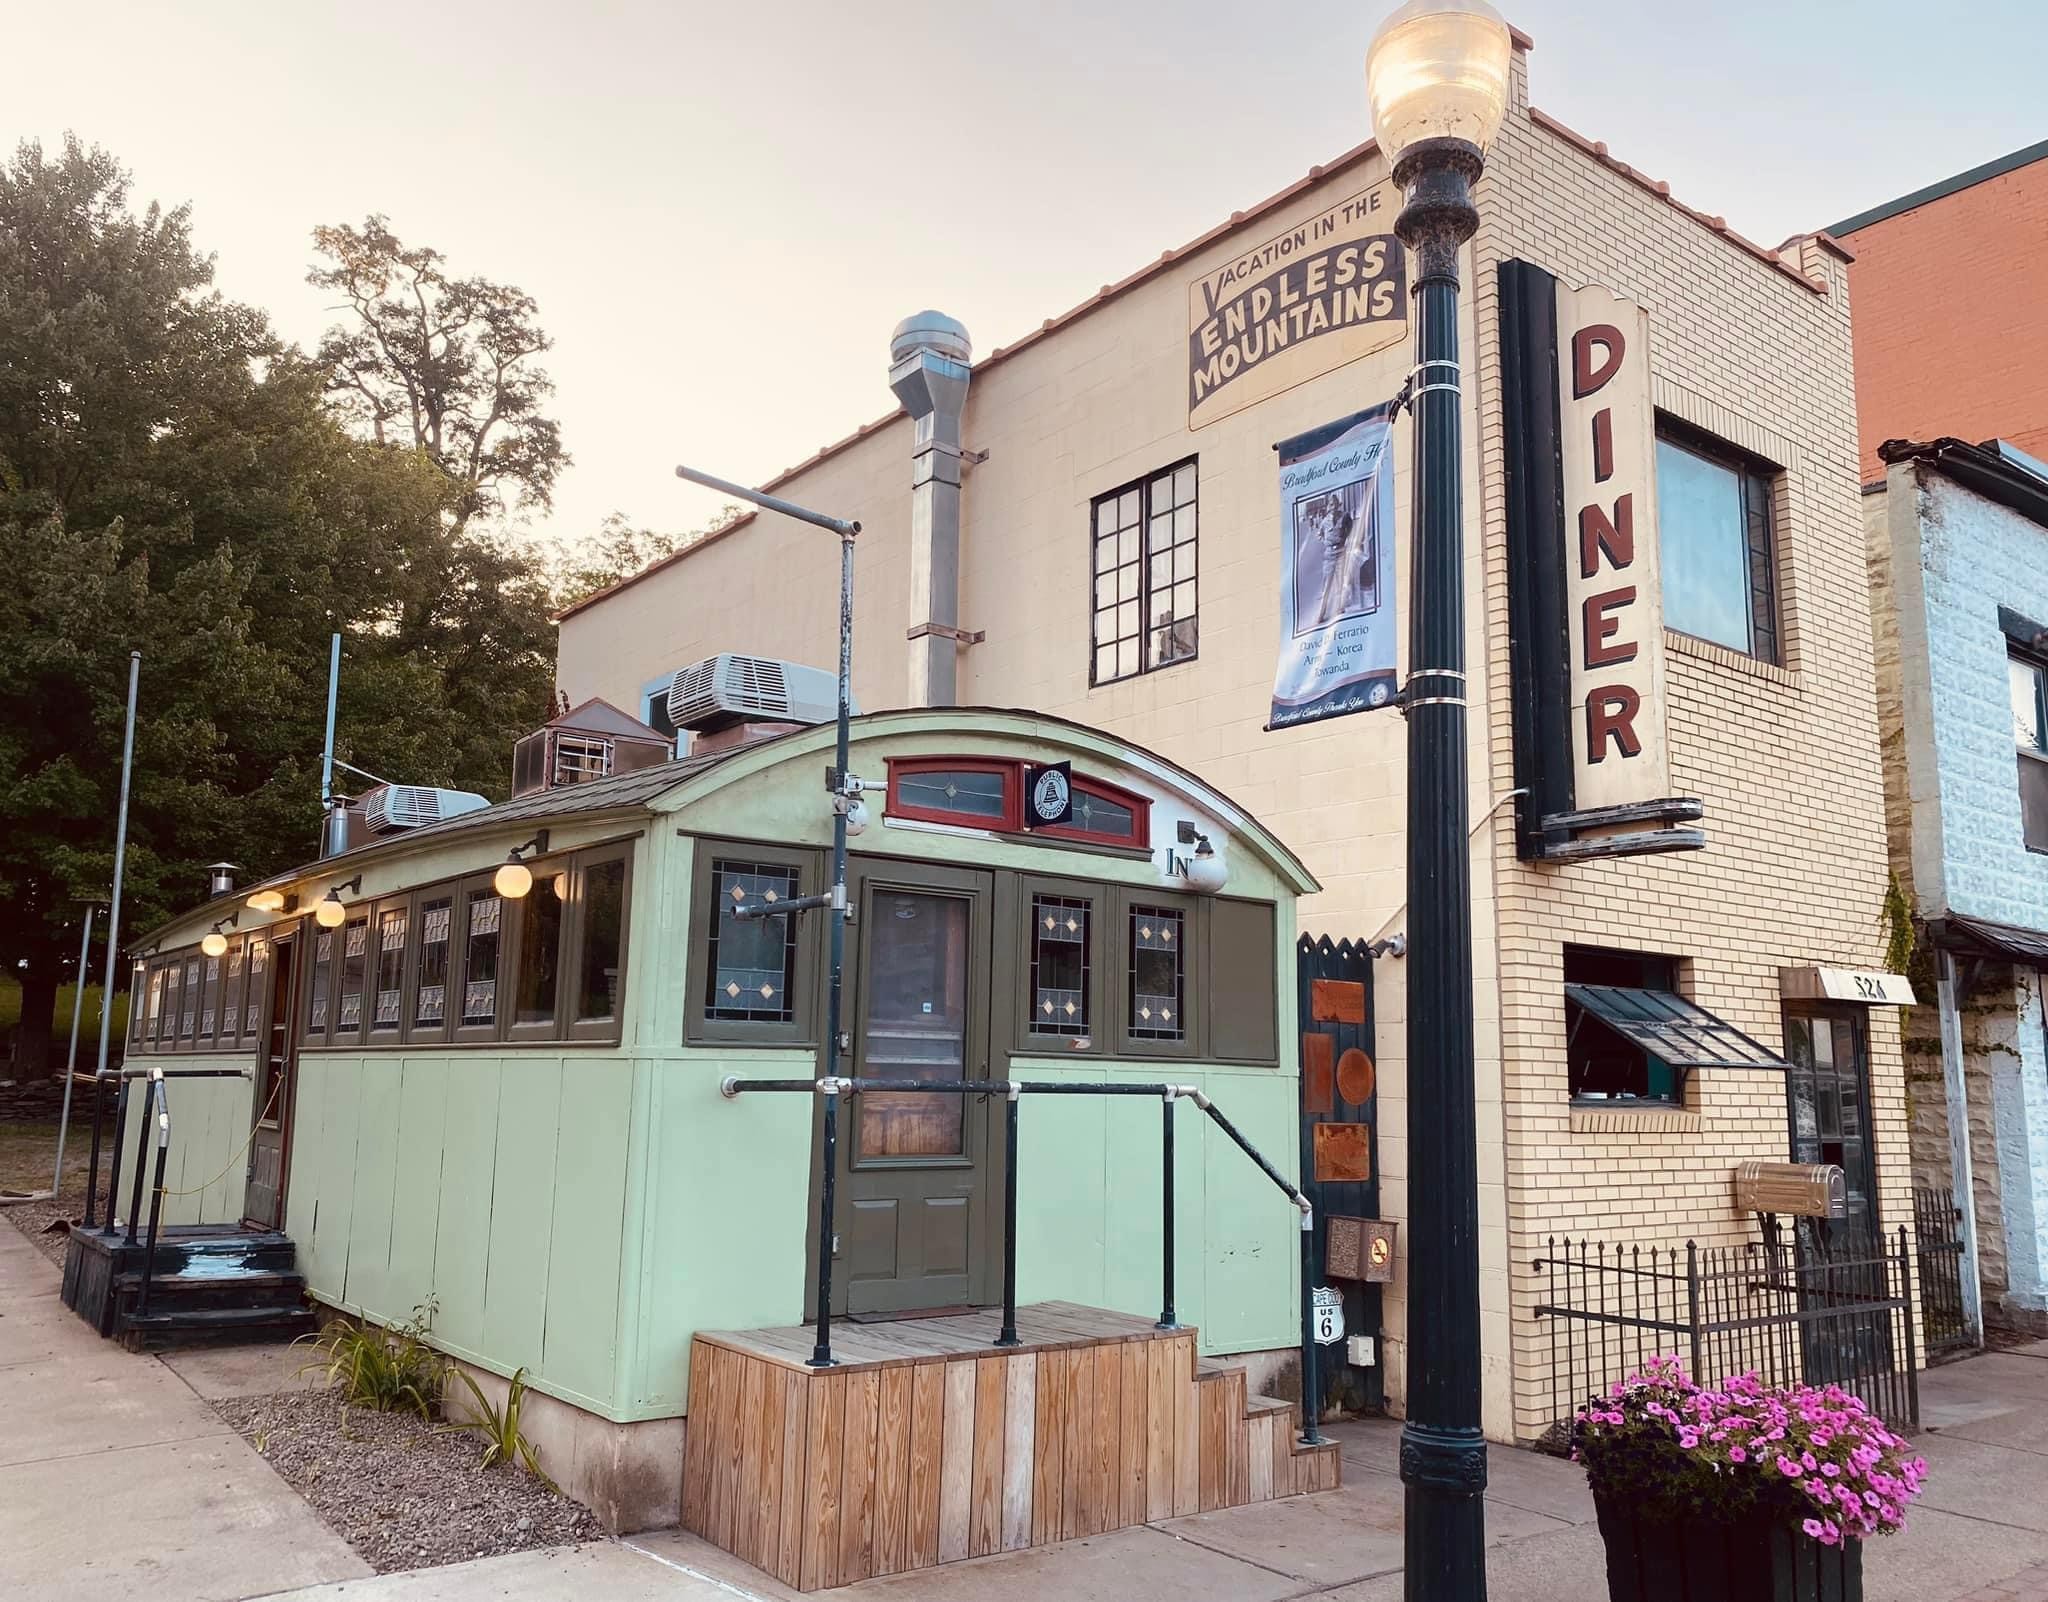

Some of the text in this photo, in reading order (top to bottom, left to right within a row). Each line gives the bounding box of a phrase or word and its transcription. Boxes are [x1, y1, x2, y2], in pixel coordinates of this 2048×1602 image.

[1201, 190, 1382, 312] VACATION IN THE
[1201, 240, 1387, 357] ENDLESS
[1193, 280, 1395, 400] MOUNTAINS
[1572, 324, 1642, 764] DINER
[1337, 643, 1363, 656] Korea
[1320, 1308, 1333, 1316] US
[1321, 1317, 1332, 1338] 6
